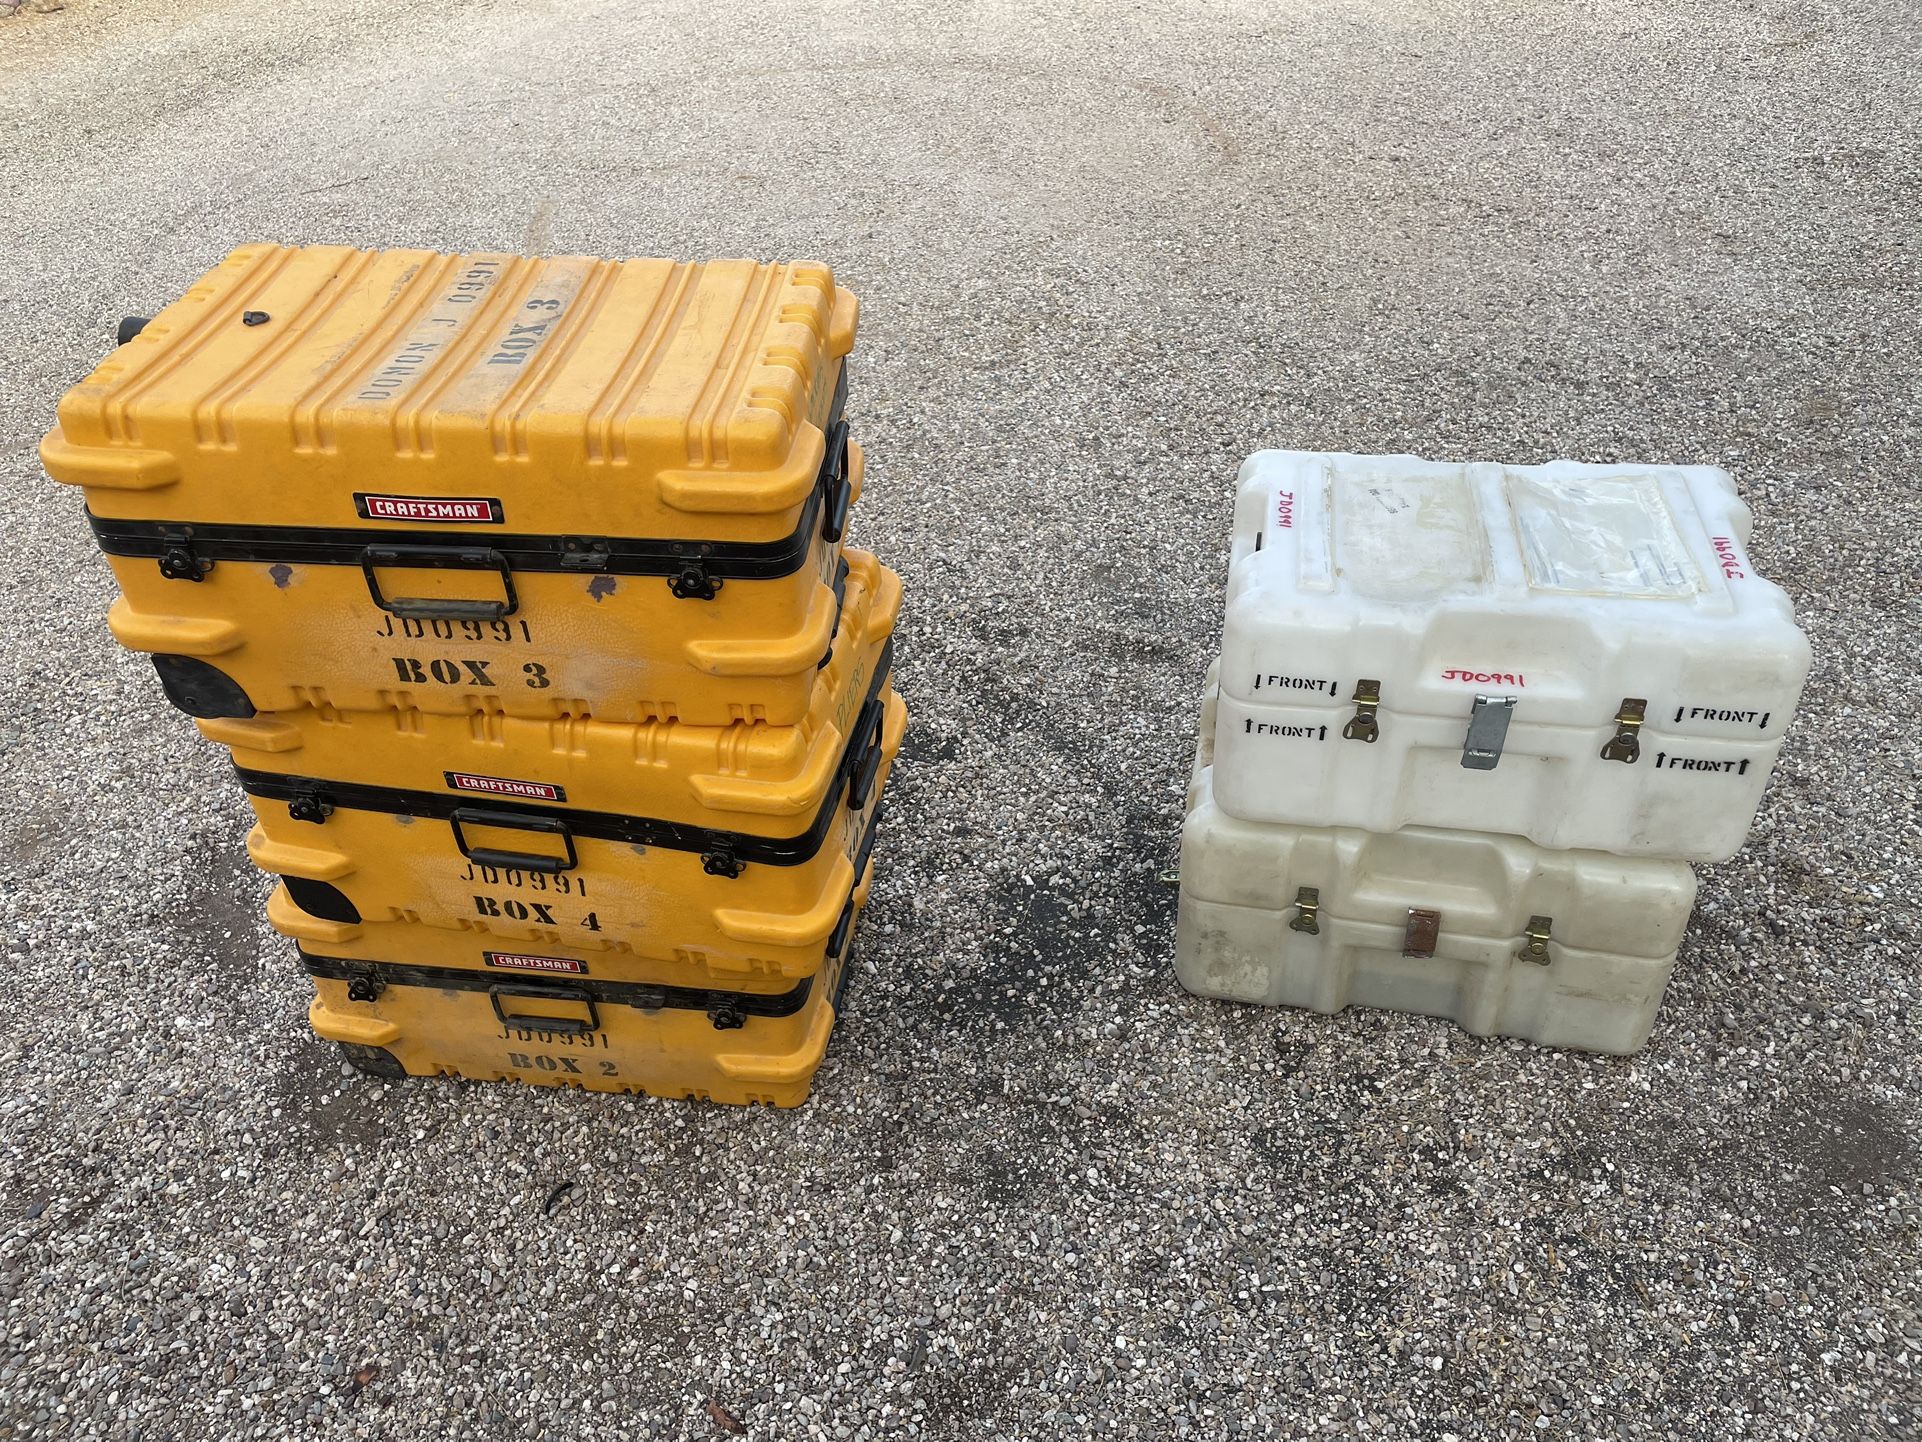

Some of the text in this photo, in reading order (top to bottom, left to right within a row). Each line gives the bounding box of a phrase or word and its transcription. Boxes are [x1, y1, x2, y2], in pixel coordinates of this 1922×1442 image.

[357, 341, 441, 400] DOMON
[431, 318, 458, 328] J
[447, 262, 500, 303] 0991
[486, 299, 561, 365] BOX 3
[375, 501, 480, 517] CRAFTSMAN
[1278, 490, 1294, 528] JD0991
[1711, 536, 1745, 580] JD0991
[376, 614, 532, 643] JD0991
[391, 657, 551, 689] BOX 3
[1267, 675, 1327, 691] FRONT
[1441, 670, 1525, 687] JD0991
[1690, 707, 1759, 723] FRONT
[1257, 723, 1316, 739] FRONT
[1668, 757, 1736, 773] FRONT
[462, 778, 546, 797] CRAFTSMAN
[473, 895, 603, 932] BOX 4
[498, 956, 571, 970] CRAFTSMAN
[507, 1052, 619, 1077] BOX 2
